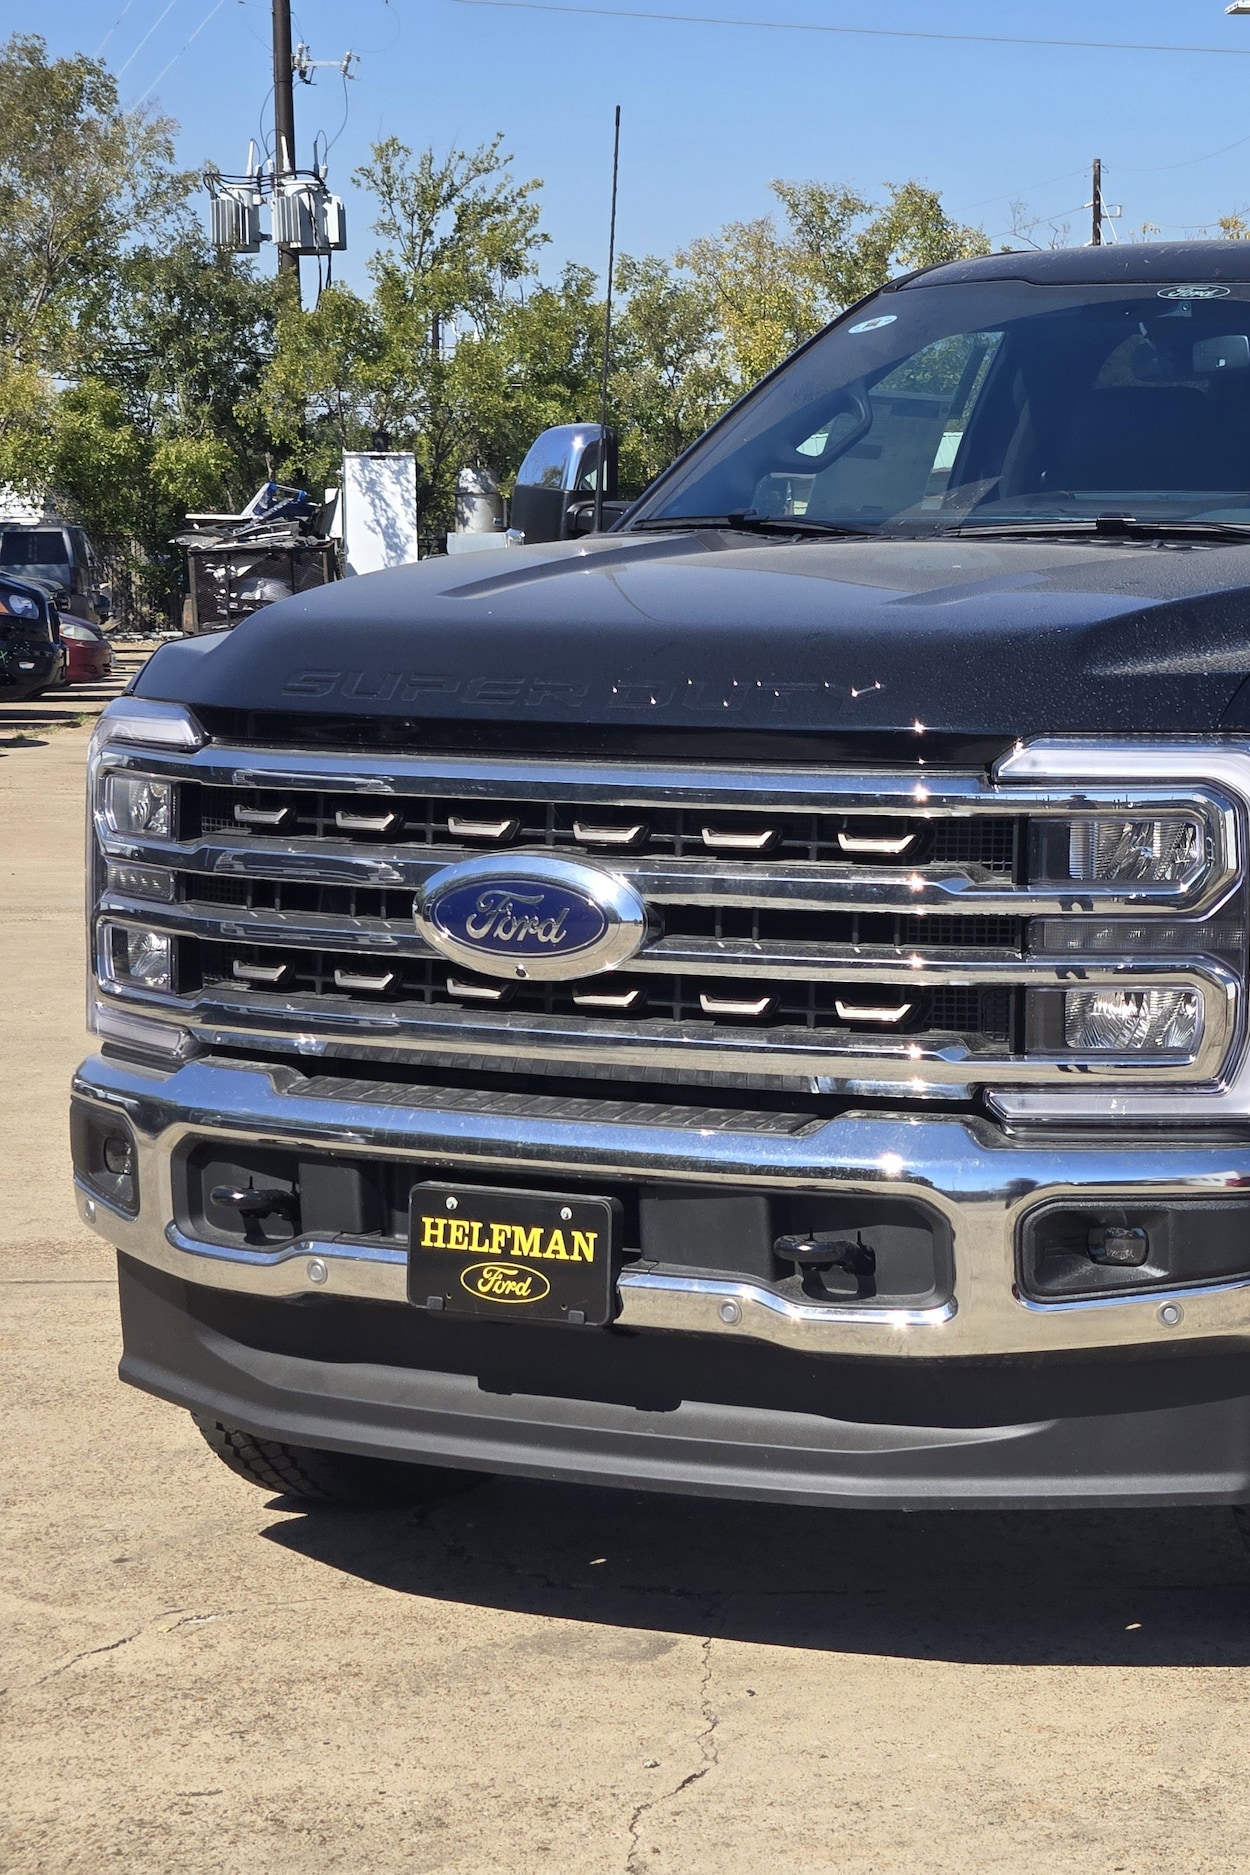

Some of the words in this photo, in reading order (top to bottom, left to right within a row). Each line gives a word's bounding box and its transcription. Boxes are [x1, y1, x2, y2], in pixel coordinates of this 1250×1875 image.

[1168, 286, 1219, 297] Ford
[282, 669, 589, 708] SUPER
[608, 679, 887, 712] DUTY
[465, 889, 571, 944] Ford
[420, 1216, 599, 1263] HELFMAN
[477, 1265, 533, 1297] Ford
